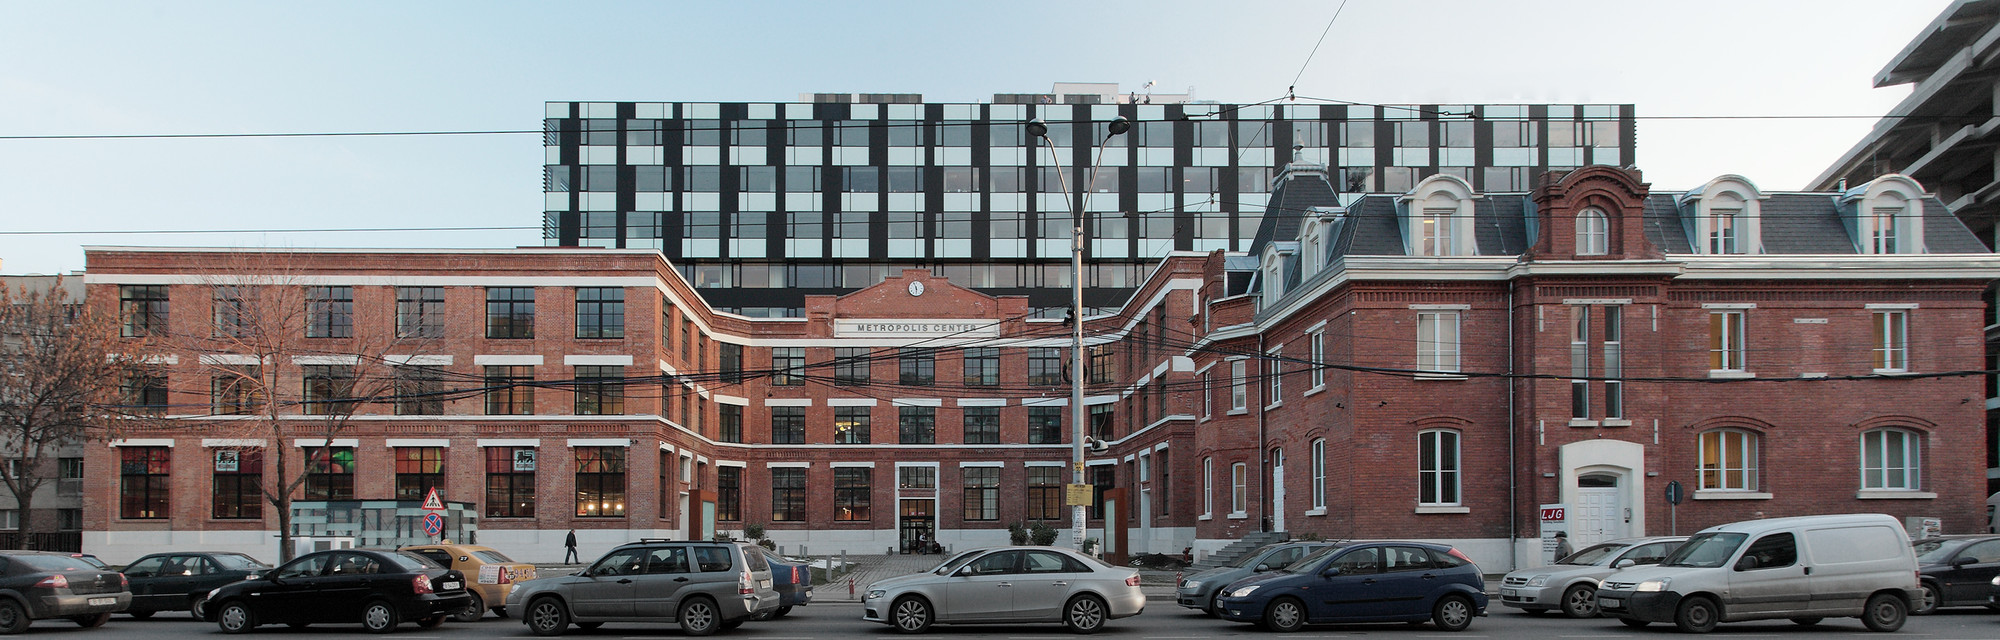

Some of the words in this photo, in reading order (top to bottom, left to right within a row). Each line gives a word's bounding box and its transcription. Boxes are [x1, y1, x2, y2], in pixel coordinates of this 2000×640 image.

[857, 324, 929, 332] METROPOLIS
[933, 324, 977, 332] CENTER
[1541, 509, 1563, 519] LJG
